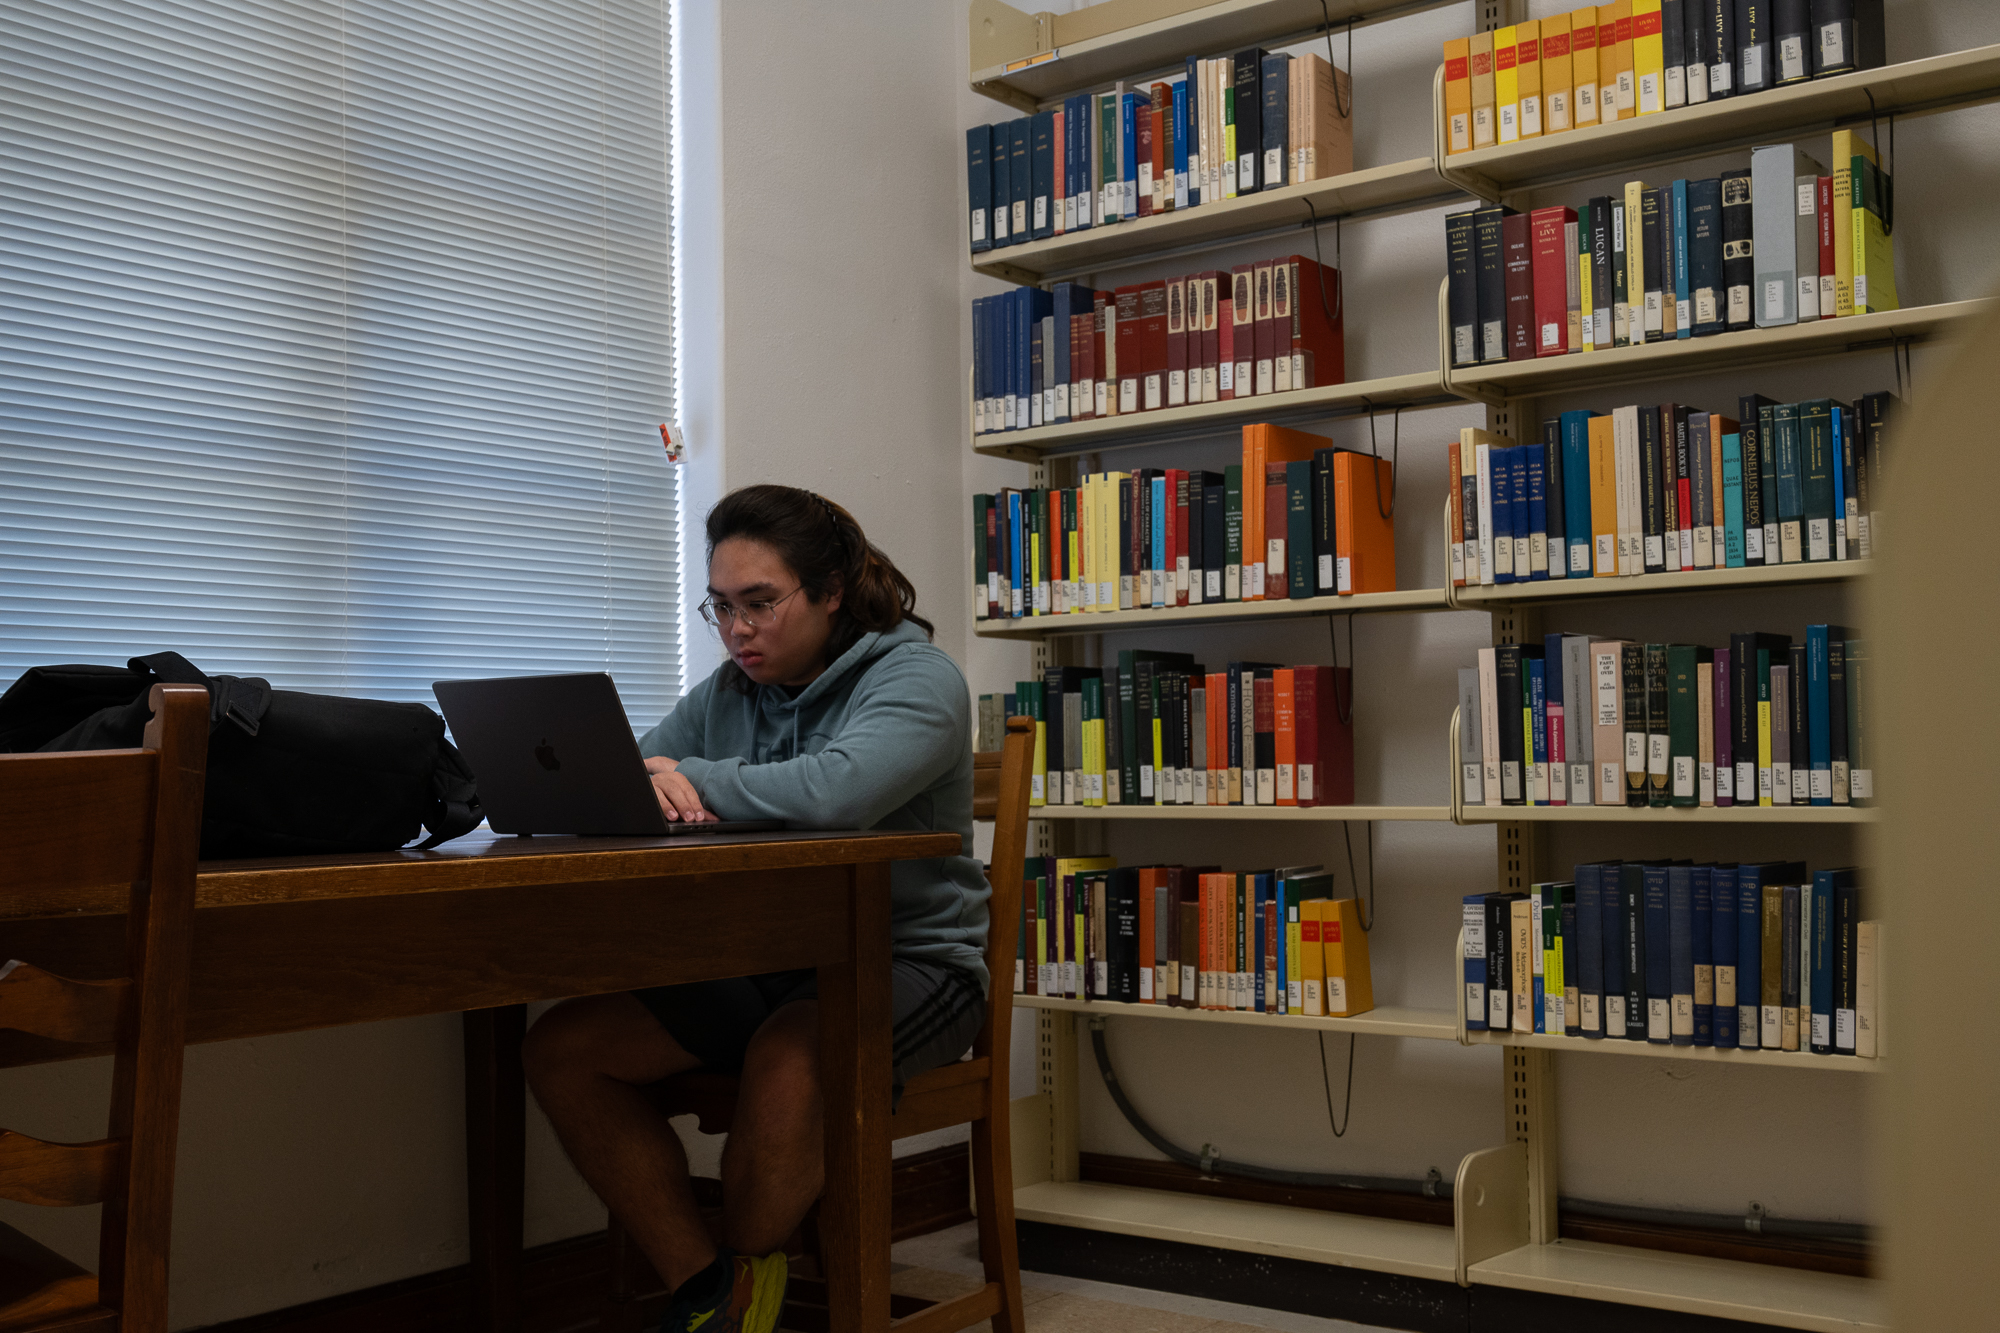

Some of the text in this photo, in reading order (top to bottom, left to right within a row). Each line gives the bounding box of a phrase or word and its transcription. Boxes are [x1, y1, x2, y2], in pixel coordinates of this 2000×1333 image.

[1540, 228, 1555, 236] LIVY
[1595, 227, 1605, 265] LUCAN
[1677, 422, 1685, 448] MARTIAL
[1678, 449, 1686, 465] BOOK
[1747, 430, 1760, 525] CORNELIUS NEPOS
[1243, 688, 1253, 741] HORACE
